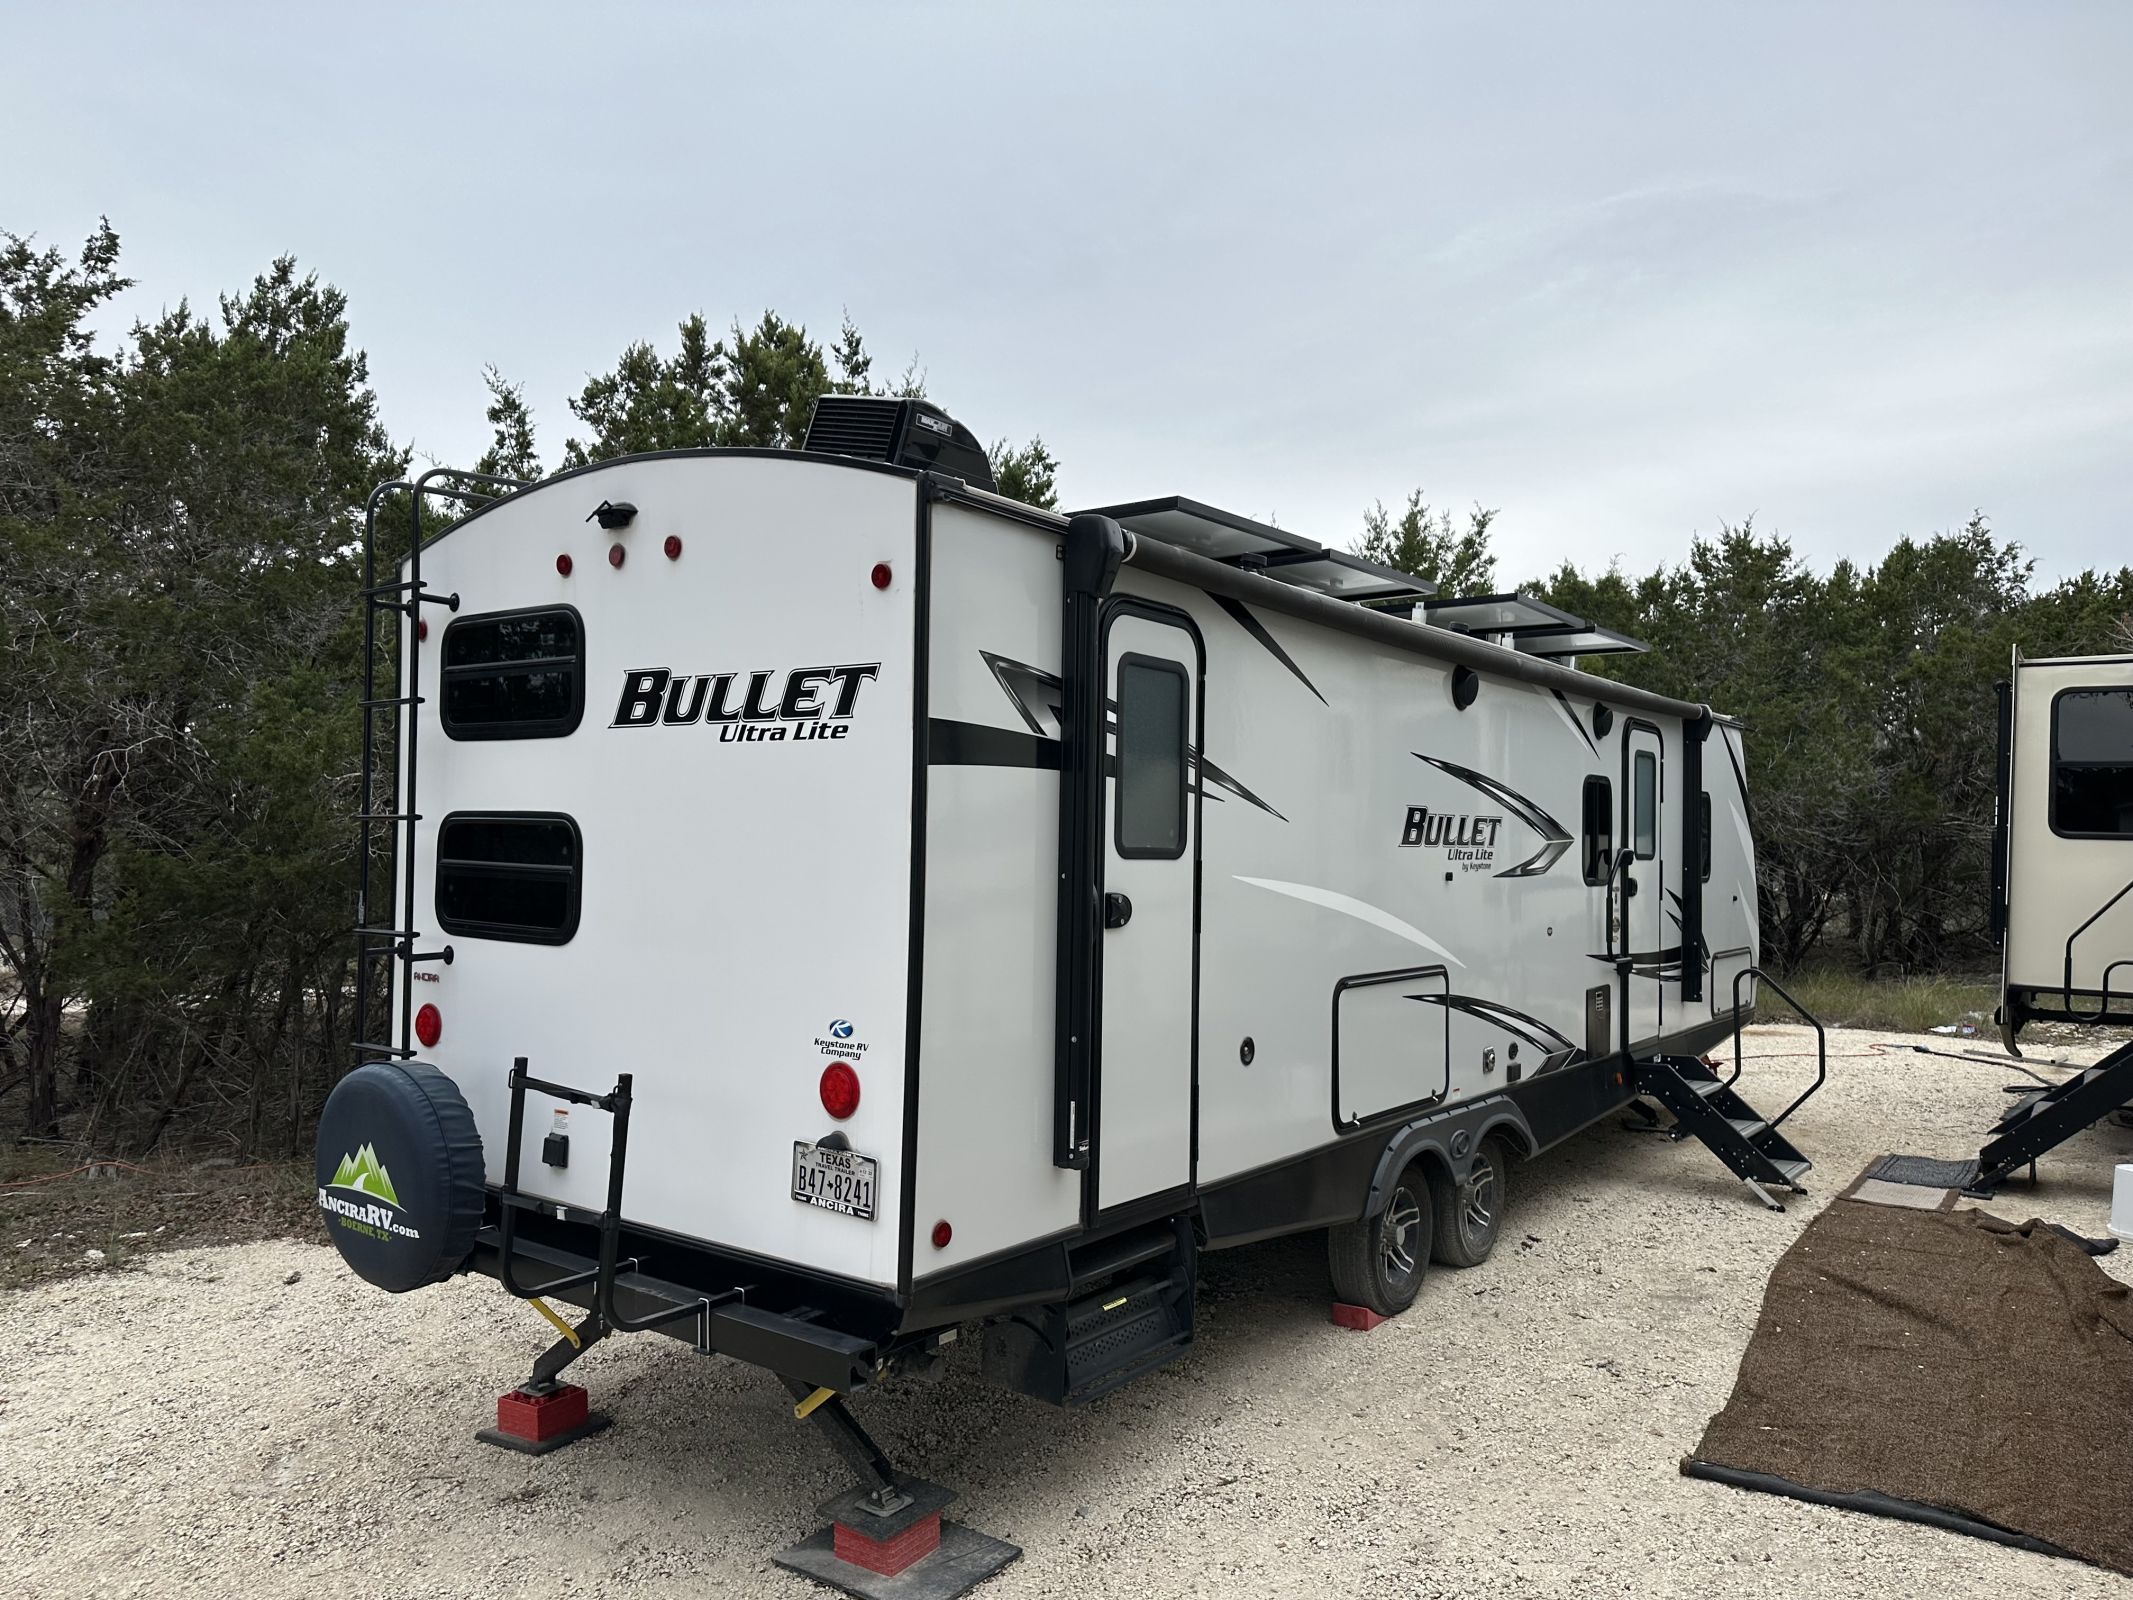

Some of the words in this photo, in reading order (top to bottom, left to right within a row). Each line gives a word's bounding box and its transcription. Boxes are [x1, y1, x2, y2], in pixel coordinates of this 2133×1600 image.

[608, 662, 881, 729] BULLET
[719, 723, 787, 743] Ultra
[793, 722, 849, 741] Lite
[1398, 804, 1503, 848] BULLET
[1447, 849, 1473, 861] Ultra
[1475, 848, 1493, 860] Lite
[1462, 862, 1468, 872] by
[1470, 862, 1491, 872] Keystone
[814, 1037, 855, 1050] Keystone
[856, 1042, 869, 1051] RV
[821, 1046, 861, 1060] Company
[819, 1151, 851, 1169] TEXAS
[815, 1162, 833, 1170] TRAVEL
[834, 1166, 855, 1176] TRAILER
[810, 1196, 854, 1215] ANCIRA
